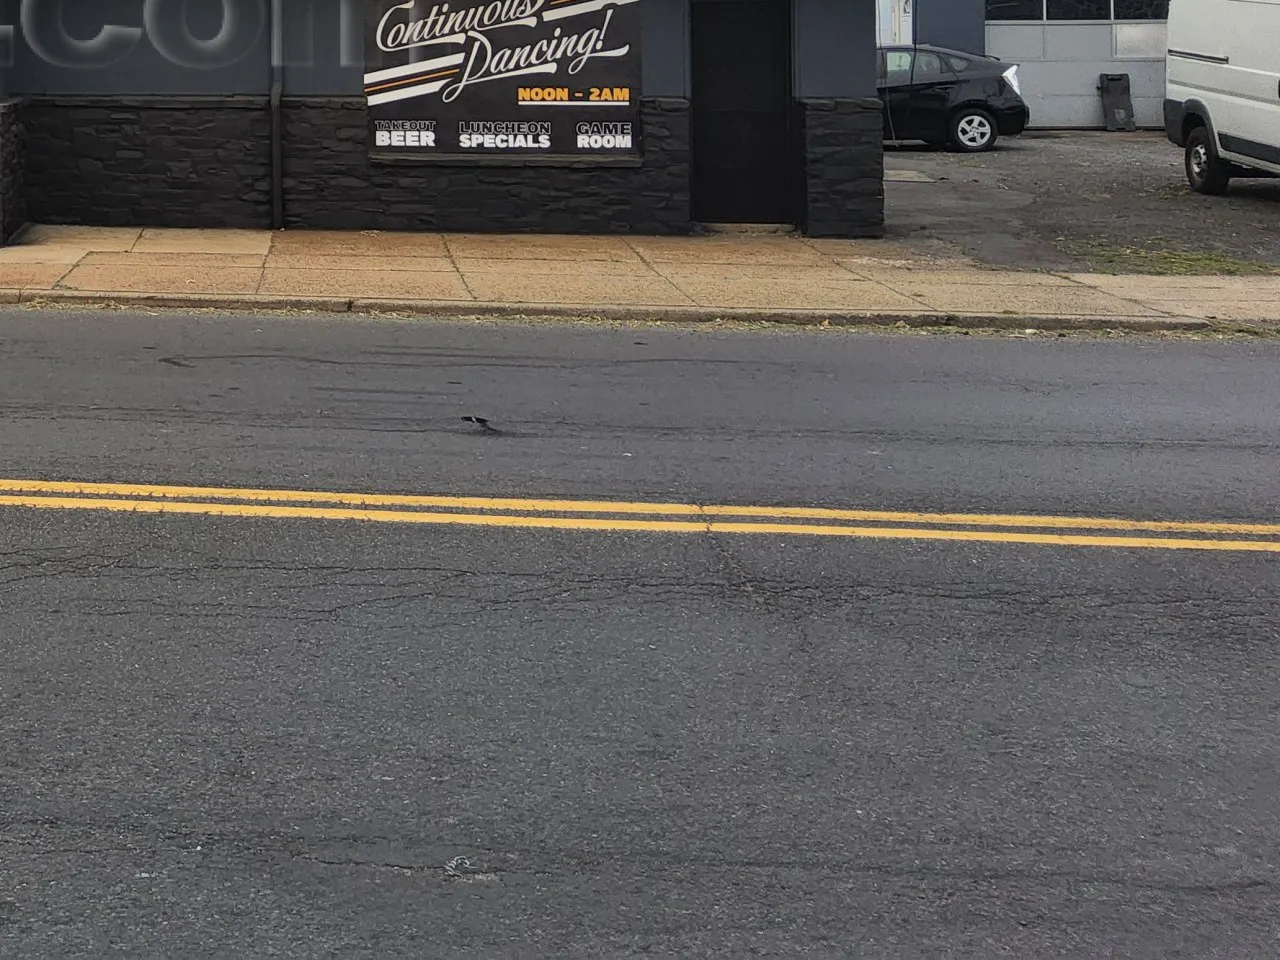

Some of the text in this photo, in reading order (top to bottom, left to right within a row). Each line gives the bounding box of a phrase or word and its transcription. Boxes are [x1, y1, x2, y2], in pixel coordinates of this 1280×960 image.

[442, 9, 630, 103] Dancing!
[518, 87, 569, 101] NOON
[588, 87, 630, 101] 2AM
[375, 120, 436, 131] TAKEOUT
[459, 121, 551, 134] LUNCHEON
[576, 122, 632, 135] GAME
[375, 131, 436, 147] BEER
[459, 134, 551, 148] SPECIALS
[576, 134, 632, 148] ROOM
